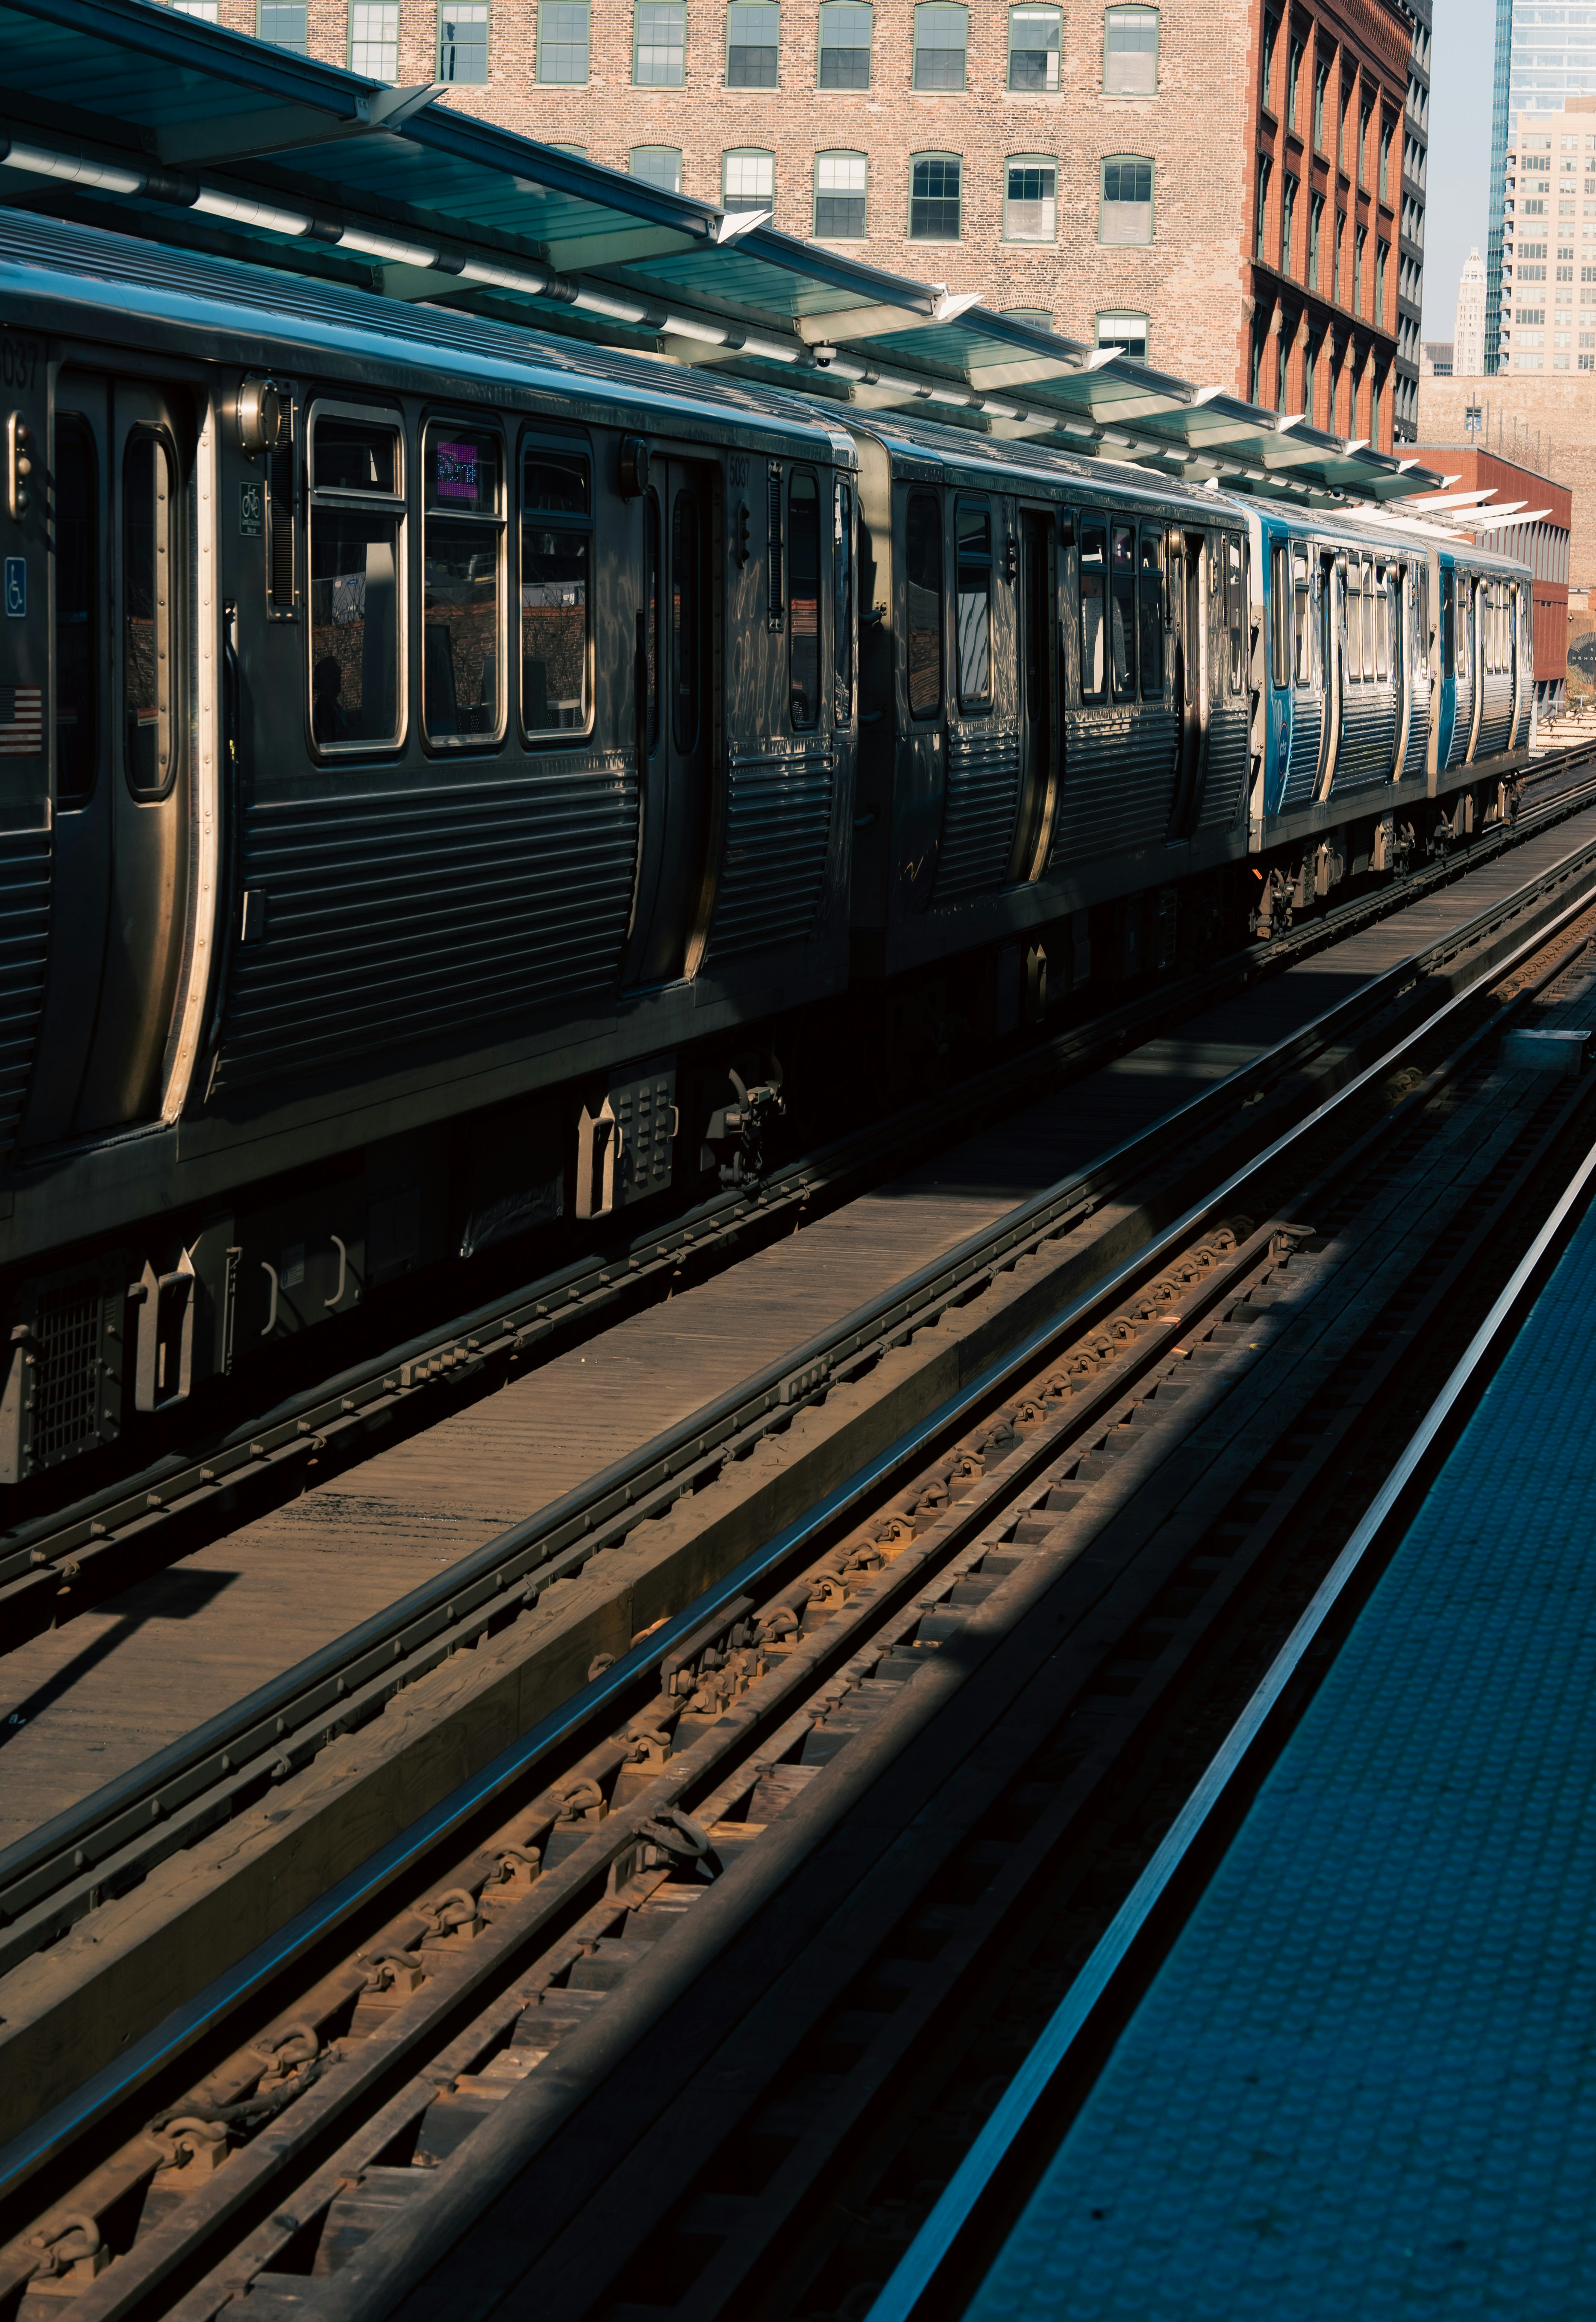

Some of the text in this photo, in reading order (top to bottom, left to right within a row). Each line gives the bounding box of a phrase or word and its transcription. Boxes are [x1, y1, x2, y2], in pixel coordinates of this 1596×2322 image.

[0, 337, 38, 391] 037
[730, 455, 750, 488] 5037
[1002, 500, 1014, 524] 5038
